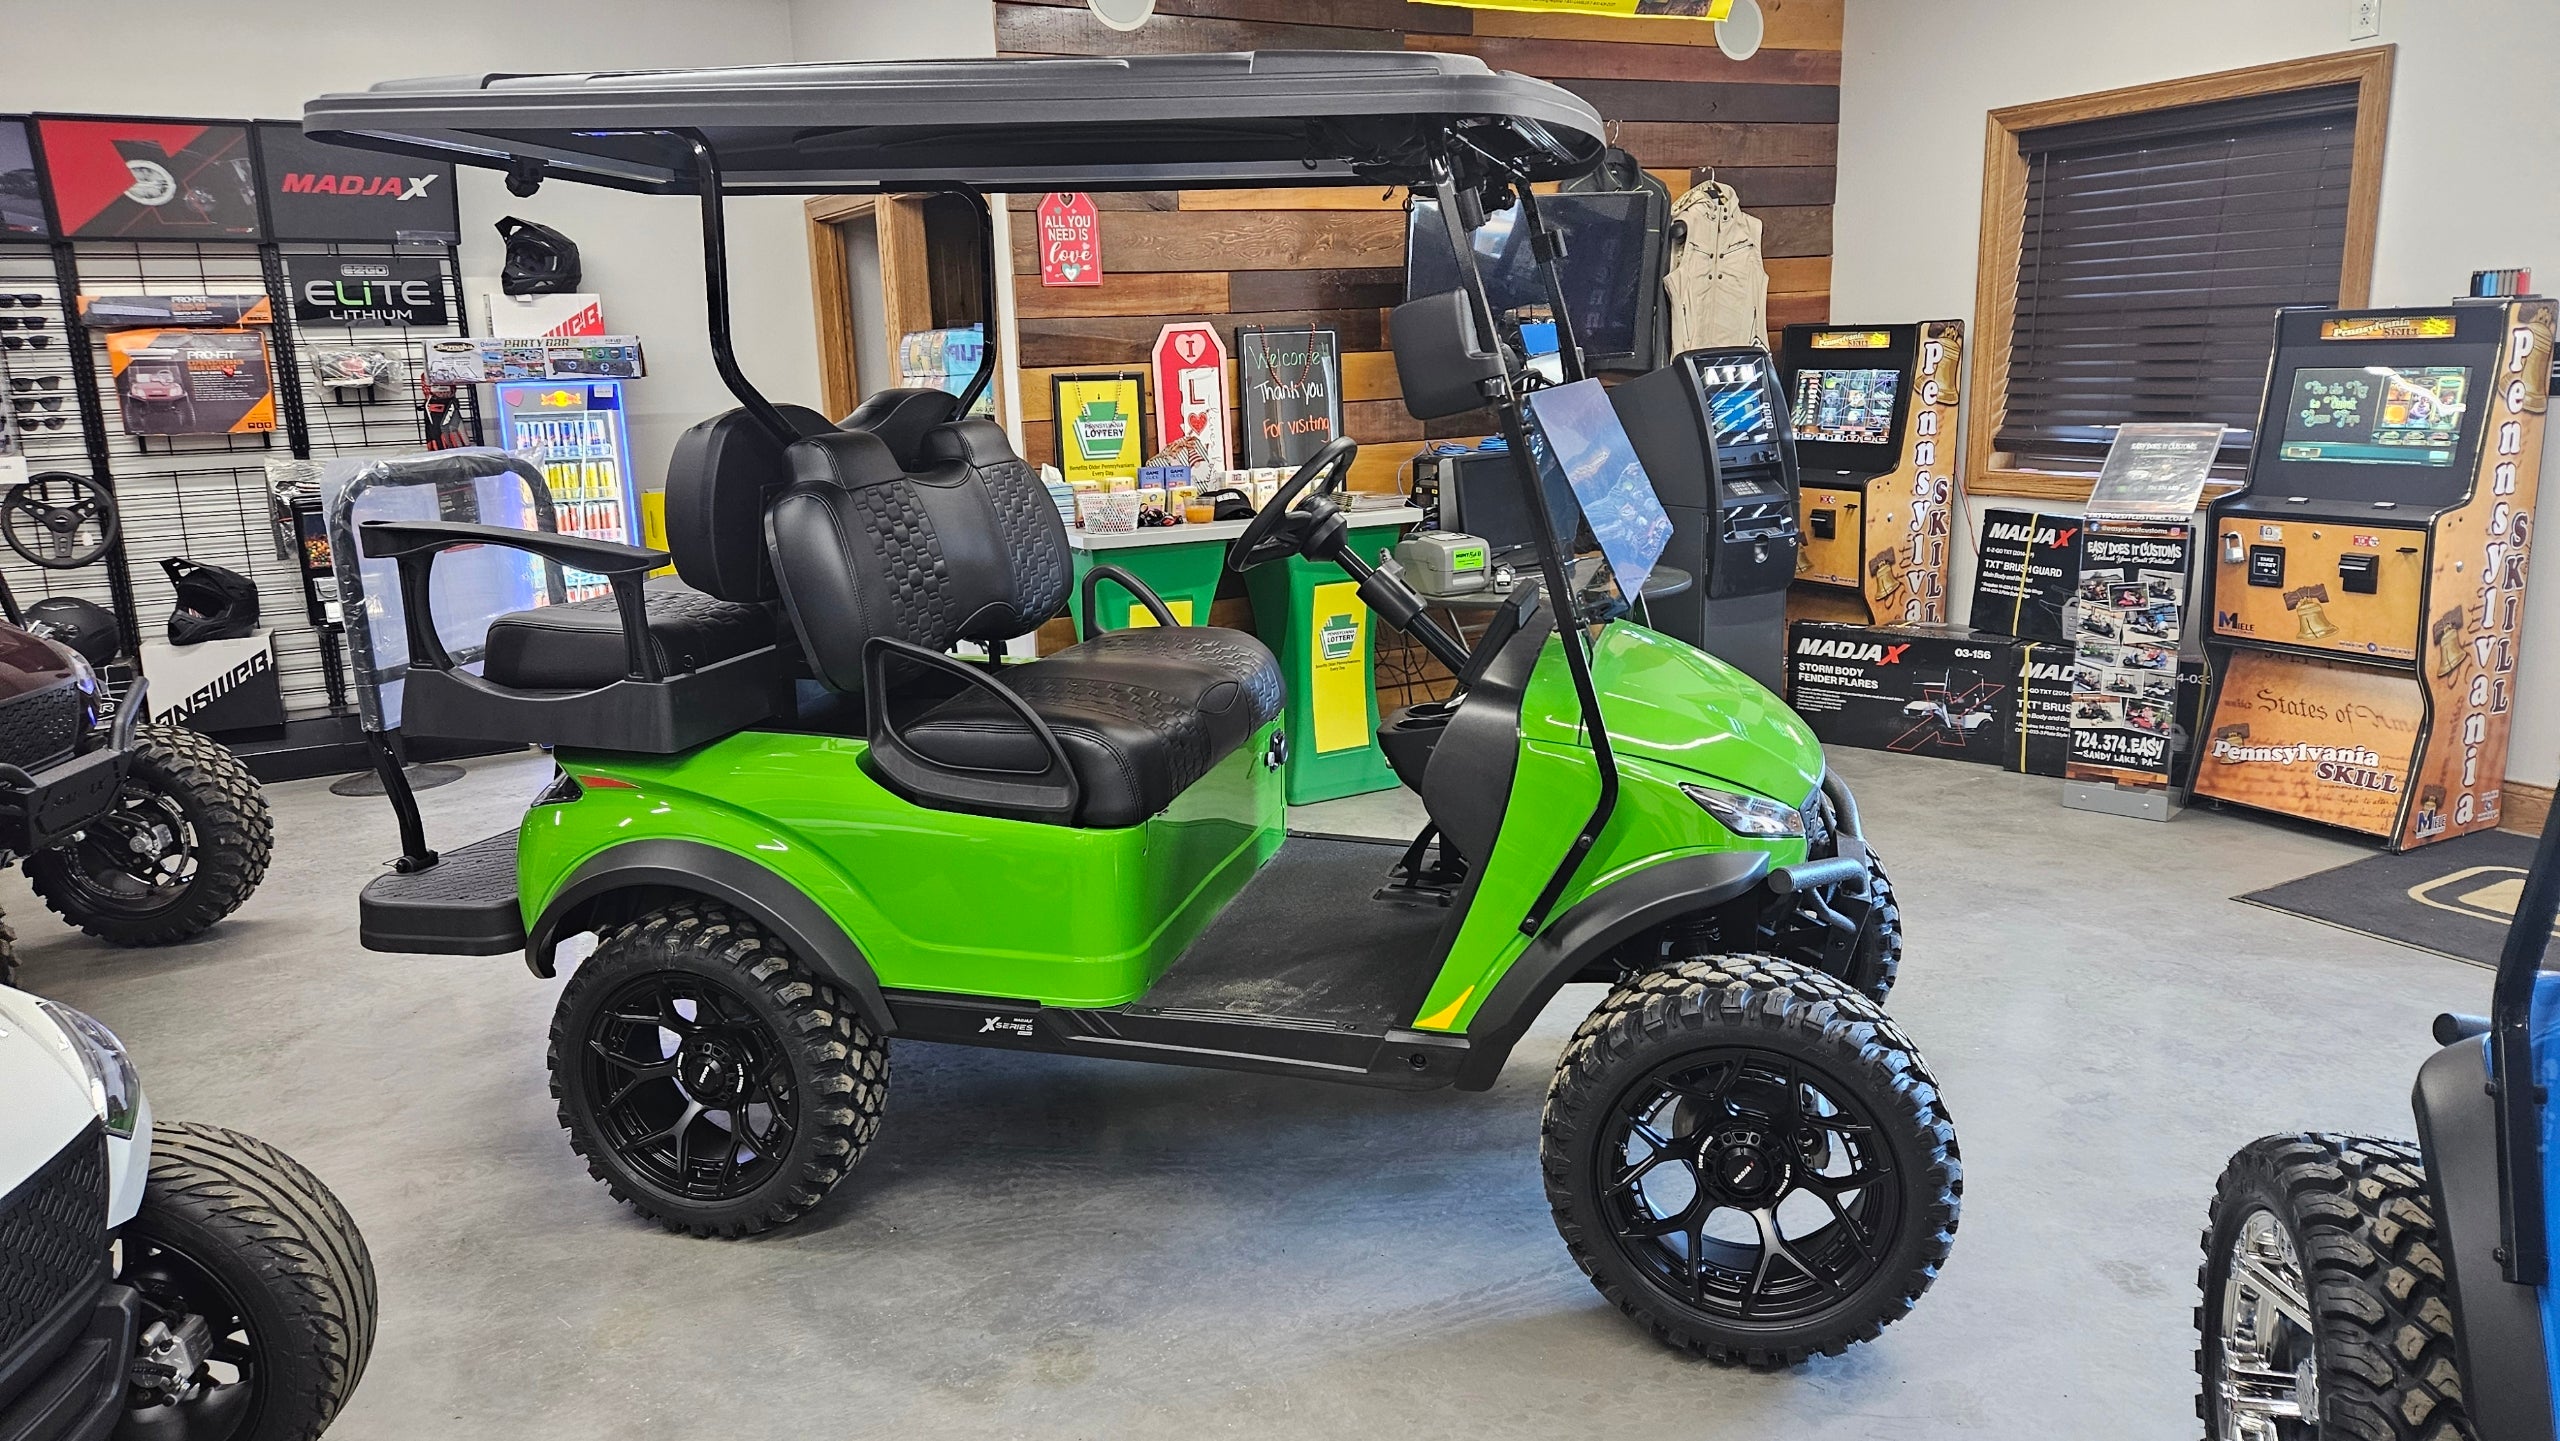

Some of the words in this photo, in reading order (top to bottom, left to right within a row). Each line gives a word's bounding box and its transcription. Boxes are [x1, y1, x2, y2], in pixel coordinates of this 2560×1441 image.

[282, 173, 439, 201] MADJAX
[1045, 216, 1065, 228] ALL
[1067, 216, 1090, 228] YOU
[1048, 228, 1076, 241] NEED
[1079, 228, 1088, 240] IS
[1049, 241, 1093, 264] love
[330, 310, 413, 320] LITHIUM
[504, 338, 544, 348] PARTY
[1186, 340, 1196, 358] I
[1253, 380, 1300, 403] Thank
[1301, 381, 1324, 405] you
[1085, 429, 1124, 438] LOTTERY
[1263, 418, 1284, 439] For
[1287, 414, 1331, 443] visiting
[1988, 523, 2078, 549] MADJAX
[2101, 525, 2168, 534] @easydoesitcustoms
[2087, 540, 2108, 555] EASY
[2108, 541, 2130, 555] DOES
[2131, 544, 2140, 555] IT
[2140, 541, 2182, 558] CUSTOMS
[2003, 561, 2032, 574] BRUSH
[2032, 565, 2063, 578] GUARD
[2218, 610, 2255, 632] MIELE
[2491, 512, 2528, 714] SKILL
[1327, 634, 1355, 643] LOTTERY
[1797, 637, 1911, 666] MADJAX
[1954, 647, 1992, 660] 03-156
[1798, 662, 1834, 674] STORM
[1834, 666, 1864, 678] BODY
[2018, 662, 2074, 681] MAD
[1798, 671, 1838, 685] FENDER
[1838, 677, 1879, 689] FLARES
[2042, 701, 2072, 713] BRUS
[2256, 688, 2328, 721] States
[2335, 702, 2354, 734] of
[2074, 730, 2165, 760] 724.374.EASY
[2212, 739, 2380, 768] Pennsylvania
[2082, 749, 2112, 762] SANDY
[2114, 753, 2139, 765] LAKE,
[2142, 757, 2154, 767] PA
[2316, 763, 2398, 793] SKILL
